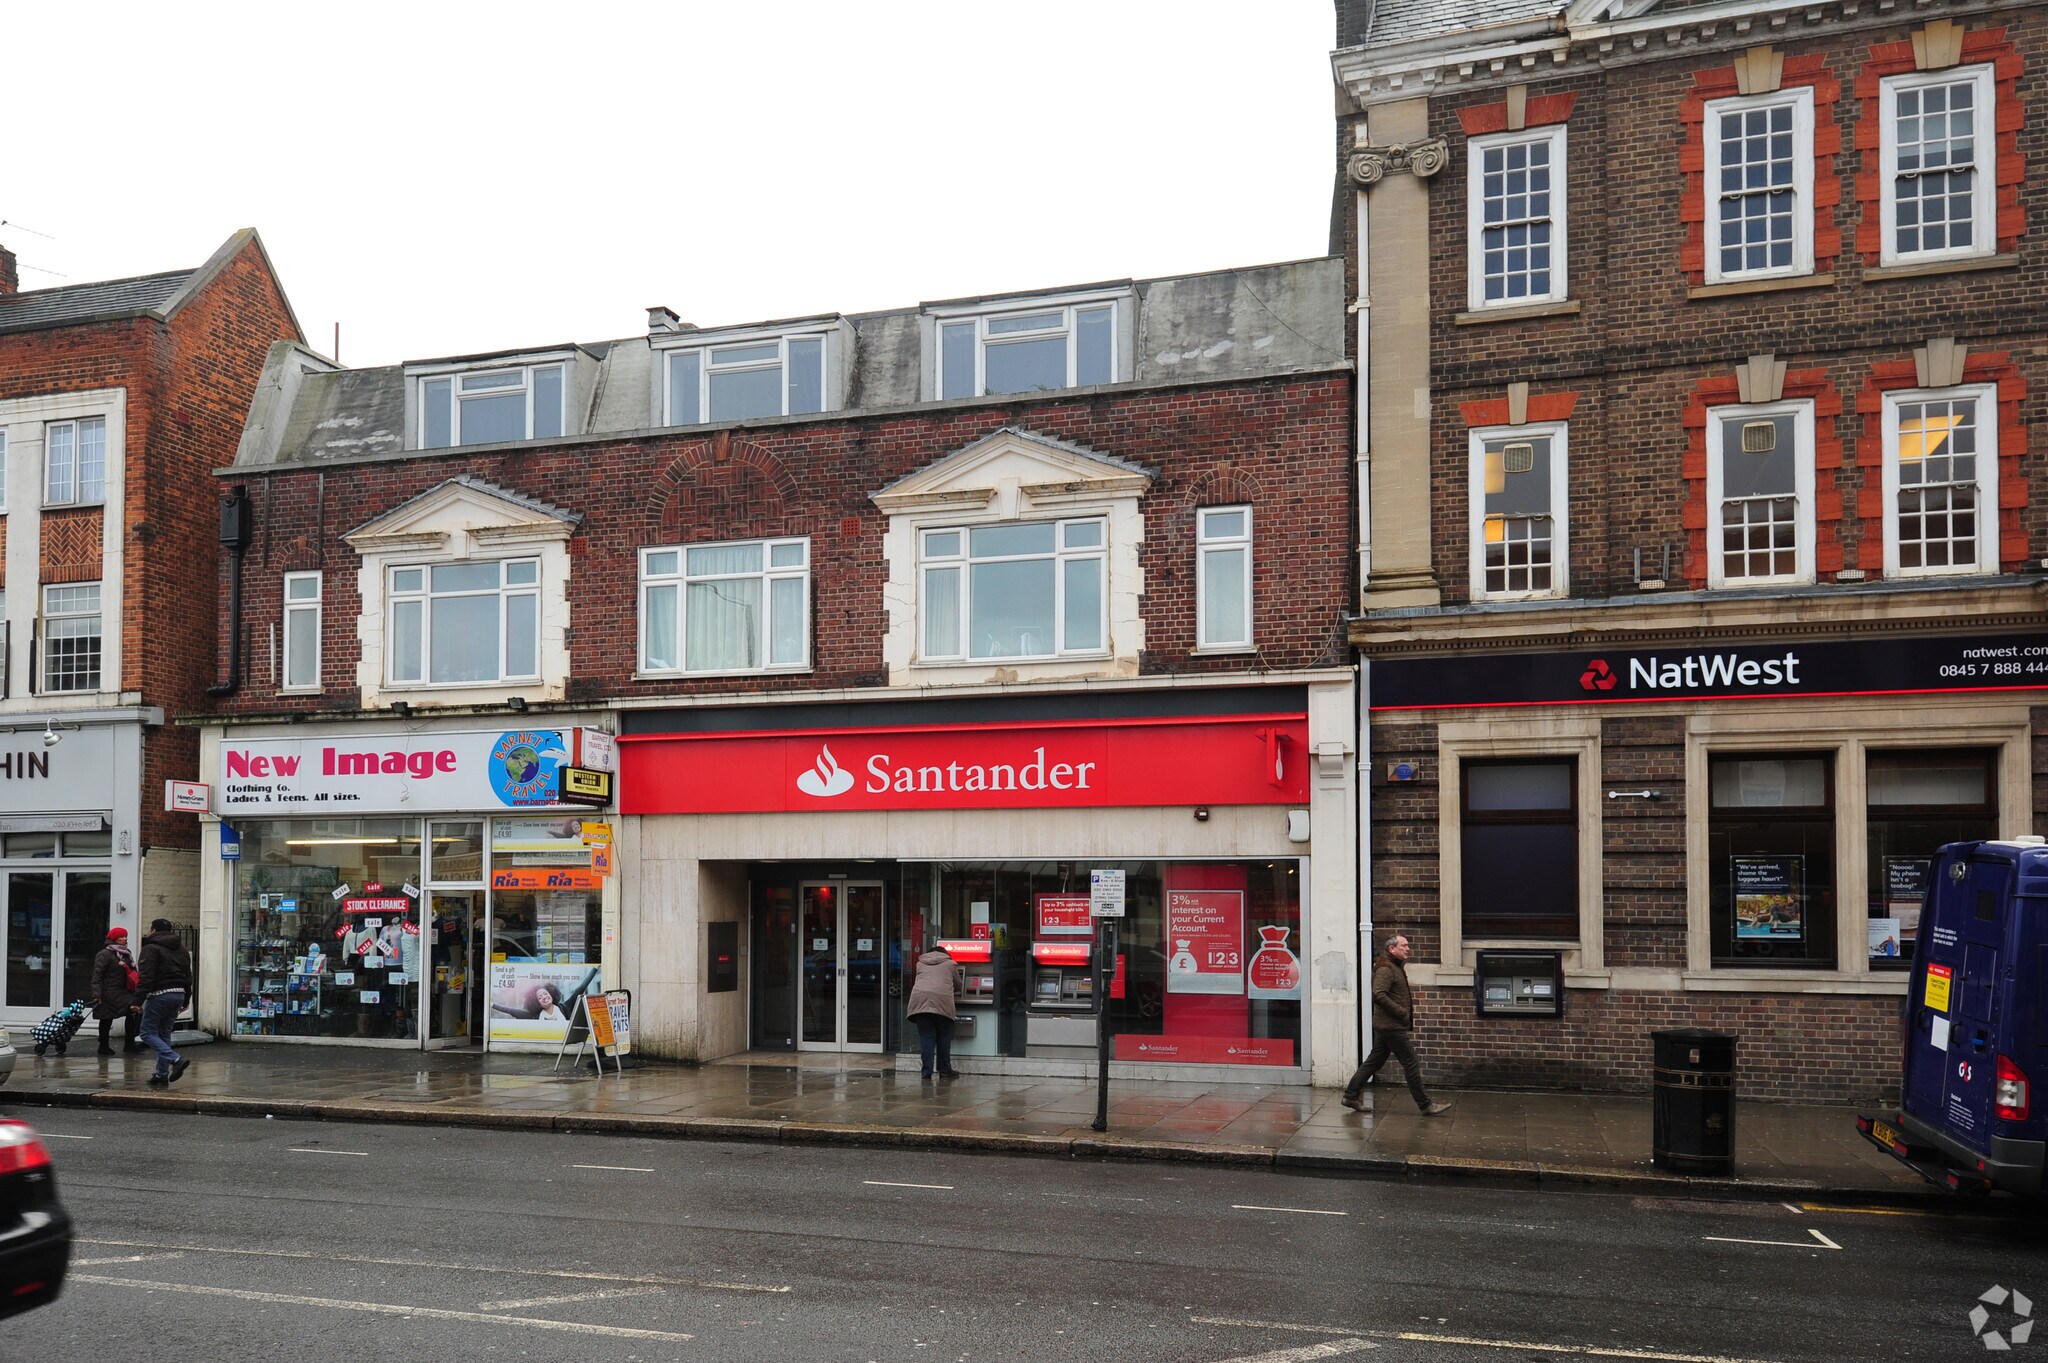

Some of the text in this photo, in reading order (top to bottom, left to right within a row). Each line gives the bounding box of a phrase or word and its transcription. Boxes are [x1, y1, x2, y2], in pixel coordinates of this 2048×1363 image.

[1630, 652, 1800, 690] NatWest
[1940, 664, 1976, 677] 0845
[1980, 663, 1990, 676] 7
[1994, 662, 2022, 675] 888
[592, 734, 608, 743] BARNET
[495, 732, 543, 761] BARNET
[227, 747, 457, 780] New Image
[866, 746, 1096, 794] Santander
[227, 783, 290, 793] Clothing Co.
[503, 770, 552, 798] TRAVEL
[227, 792, 361, 803] Ladies & Teens. All sizes.
[595, 852, 608, 867] Ria
[494, 872, 519, 887] Ria
[547, 871, 573, 887] Ria
[335, 886, 348, 897] sale
[405, 885, 418, 896] sale
[346, 900, 406, 911] STOCK CLEARANCE
[1172, 895, 1190, 905] 3%
[1172, 907, 1203, 915] interest
[1172, 916, 1191, 925] your
[337, 924, 350, 936] sale
[404, 922, 418, 934] sale
[359, 940, 373, 953] sale
[379, 941, 391, 953] sale
[1260, 955, 1272, 963] 3%
[498, 979, 515, 988] £4.90
[610, 1006, 628, 1018] RAVEL
[614, 1020, 629, 1033] ENTS
[1148, 1044, 1178, 1052] Santander
[1237, 1047, 1268, 1056] Santander
